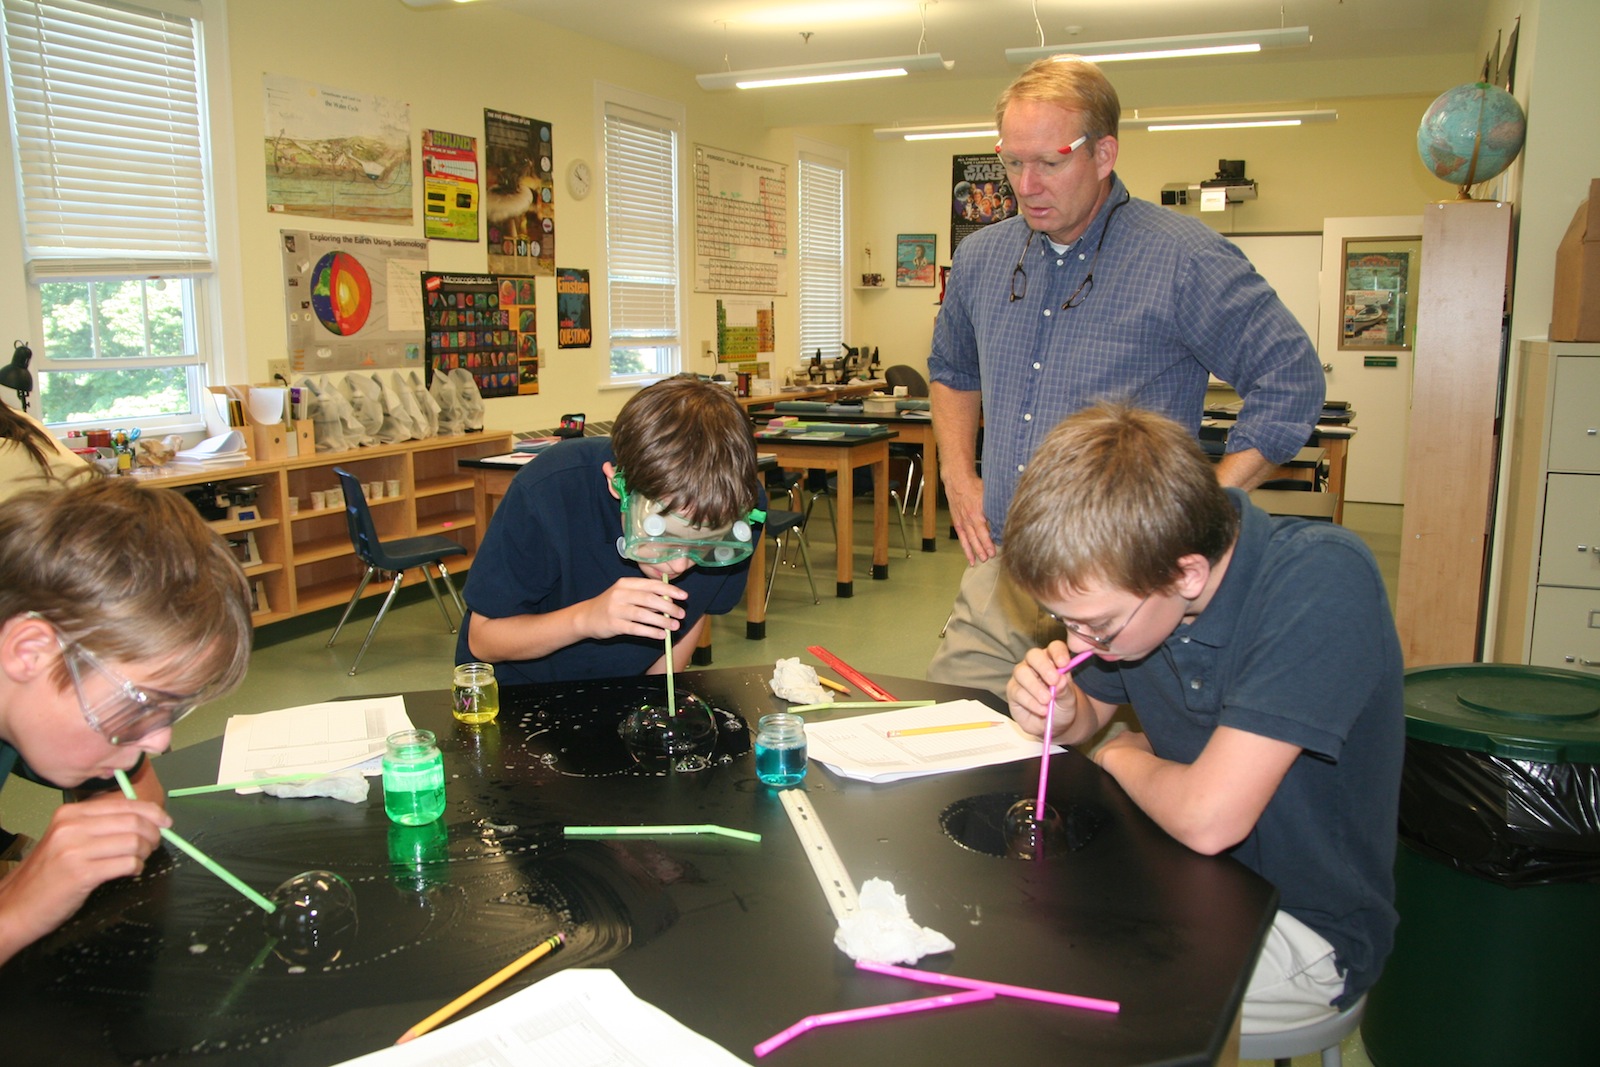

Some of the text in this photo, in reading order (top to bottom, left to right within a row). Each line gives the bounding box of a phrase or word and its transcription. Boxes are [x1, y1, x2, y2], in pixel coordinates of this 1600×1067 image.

[433, 131, 471, 151] SOUND
[964, 164, 1006, 173] STAR
[964, 172, 1006, 181] WARS
[309, 233, 426, 249] Exploring the Earth Using Seismology
[558, 276, 589, 293] Einstein
[560, 329, 590, 345] QUESTIONS
